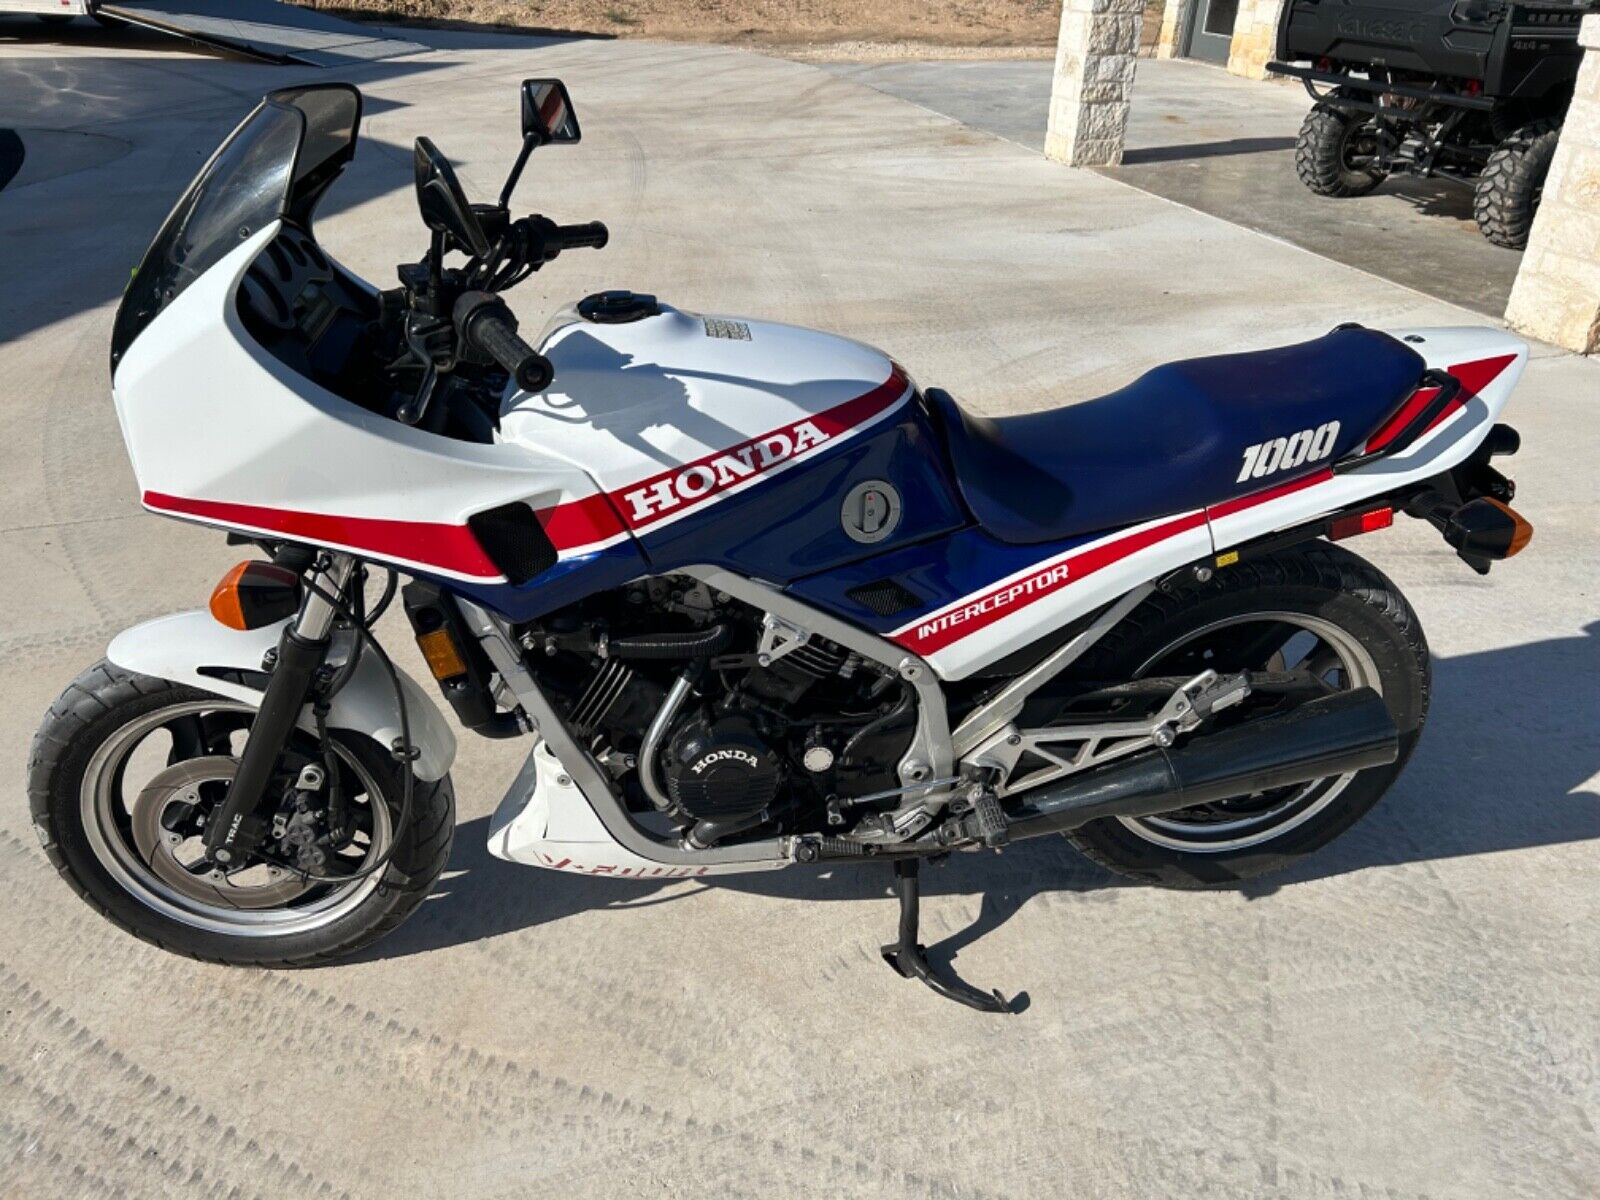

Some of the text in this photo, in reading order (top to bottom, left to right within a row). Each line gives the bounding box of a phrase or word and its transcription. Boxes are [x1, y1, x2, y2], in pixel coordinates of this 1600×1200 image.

[623, 421, 830, 522] HONDA
[1236, 420, 1341, 484] 1000
[917, 564, 1069, 640] INTERCEPTOR
[691, 750, 758, 775] HONDA
[224, 813, 243, 844] TRAC
